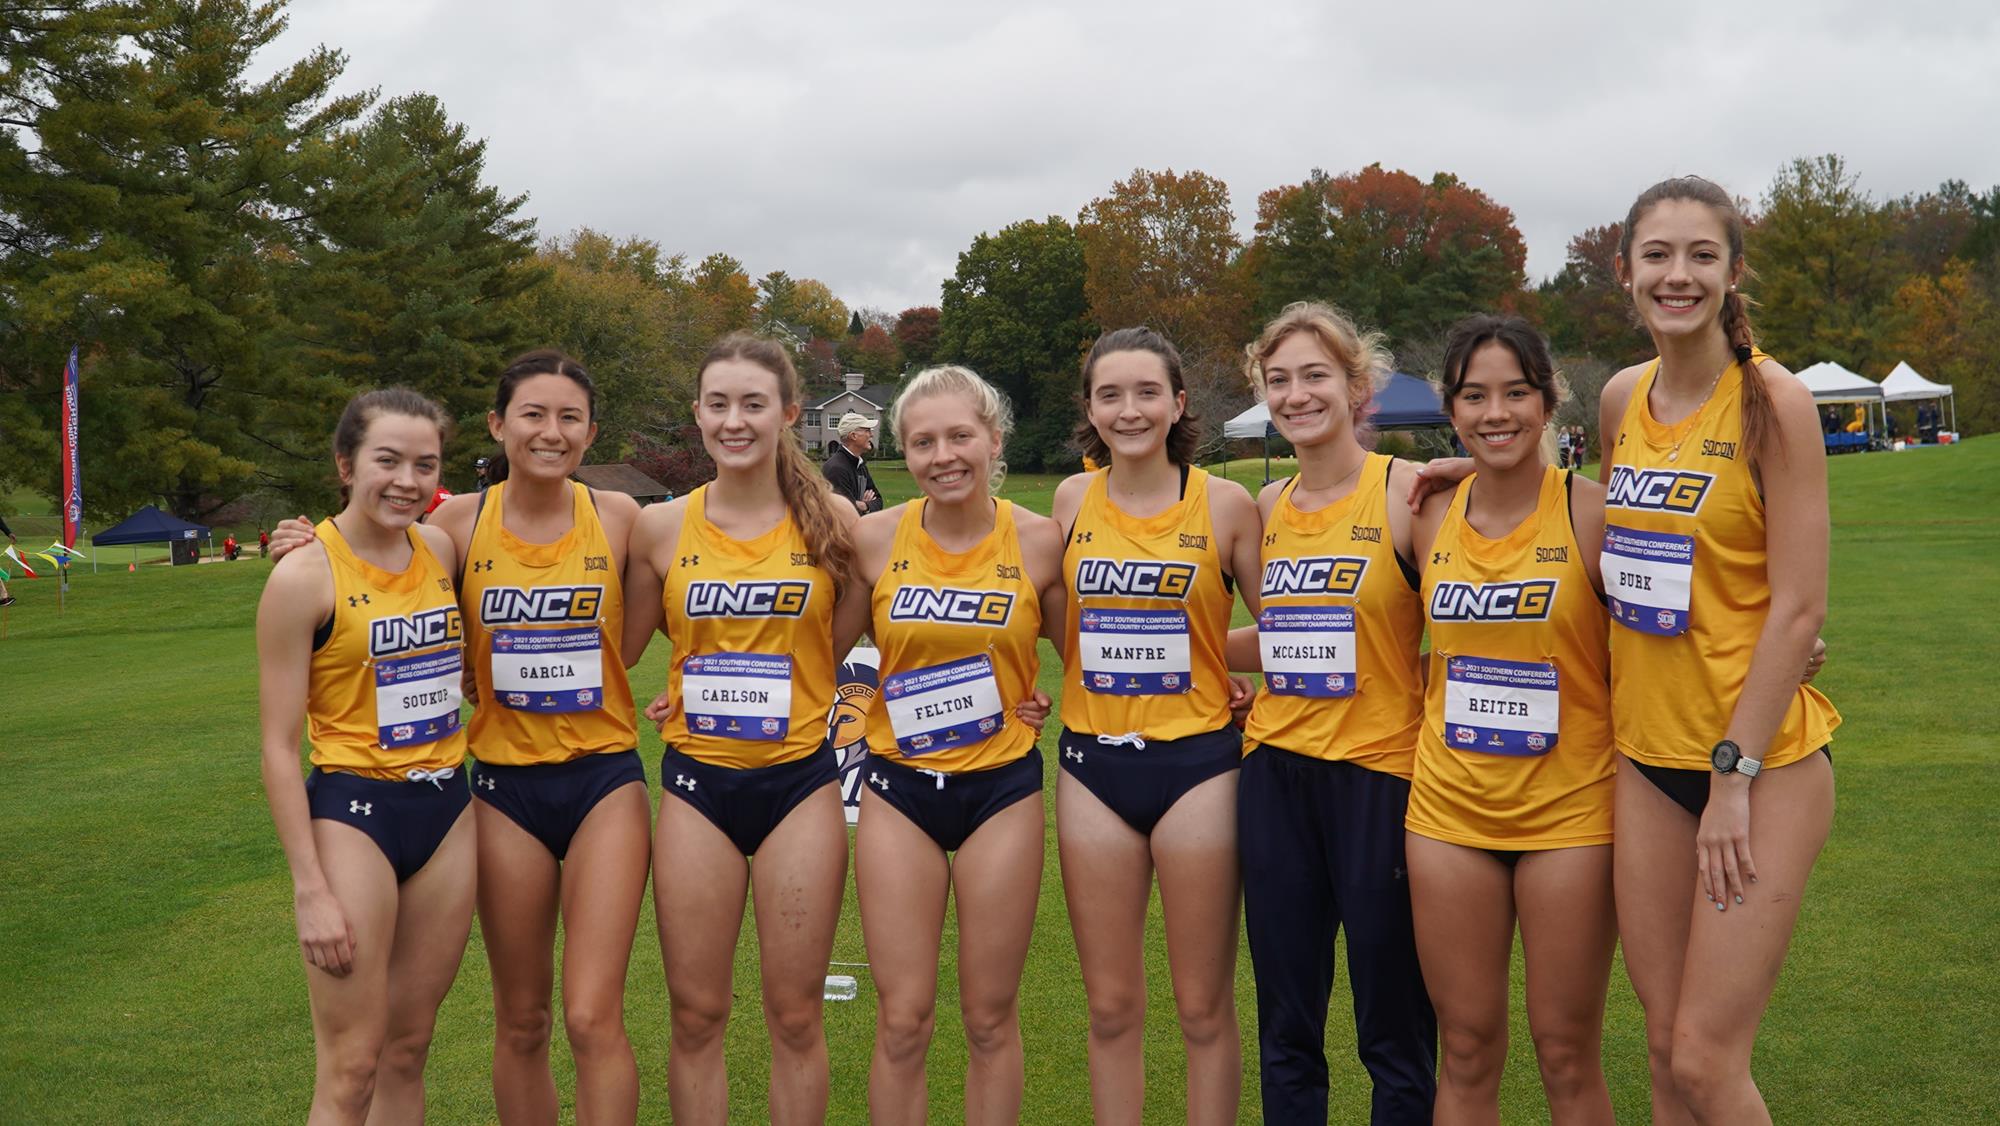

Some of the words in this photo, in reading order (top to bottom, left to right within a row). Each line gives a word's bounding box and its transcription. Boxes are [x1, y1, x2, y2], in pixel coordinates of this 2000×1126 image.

[1702, 439, 1736, 460] SOCON
[1606, 465, 1716, 516] UNCG
[1179, 533, 1208, 550] SOCON
[1351, 526, 1382, 543] SOCON
[1624, 536, 1648, 547] SOUTHERN
[1648, 540, 1690, 551] CONFERENCE
[1536, 546, 1568, 563] SOCON
[1624, 545, 1643, 554] COUNTRY
[1643, 548, 1690, 560] CHAMPIONSHIPS
[997, 564, 1021, 580] SOCON
[1076, 558, 1198, 599] UNCG
[1262, 556, 1370, 599] UNCG
[1619, 572, 1652, 591] BURK
[482, 586, 603, 625] UNCG
[686, 580, 812, 619] UNCG
[889, 585, 1016, 628] UNCG
[1431, 579, 1560, 622] UNCG
[1146, 616, 1185, 624] CONFERENCE
[1658, 613, 1676, 627] SOCON
[370, 605, 463, 658] UNCG
[562, 632, 598, 642] CONFERENCE
[557, 640, 599, 649] CHAMPIONSHIPS
[1102, 646, 1165, 660] MANFRE
[1273, 646, 1336, 659] MCCASLIN
[397, 665, 410, 673] 2021
[410, 660, 438, 671] SOUTHERN
[520, 664, 575, 679] GARCIA
[719, 659, 751, 667] SOUTHERN
[751, 660, 790, 669] CONFERENCE
[746, 668, 789, 676] CHAMPIONSHIPS
[1466, 664, 1480, 672] 2021
[1481, 665, 1513, 675] SOUTHERN
[1514, 669, 1556, 679] CONFERENCE
[904, 677, 918, 686] 2021
[919, 670, 950, 682] SOUTHERN
[951, 660, 989, 674] CONFERENCE
[905, 684, 922, 692] CROSS
[922, 677, 947, 688] COUNTRY
[947, 667, 990, 682] CHAMPIONSHIPS
[1484, 673, 1508, 682] COUNTRY
[1509, 676, 1556, 686] CHAMPIONSHIPS
[403, 688, 448, 708] SOUKUP
[702, 689, 768, 703] CARLSON
[915, 696, 974, 720] FELTON
[1469, 698, 1529, 716] REITER
[1527, 735, 1546, 748] SOCON
